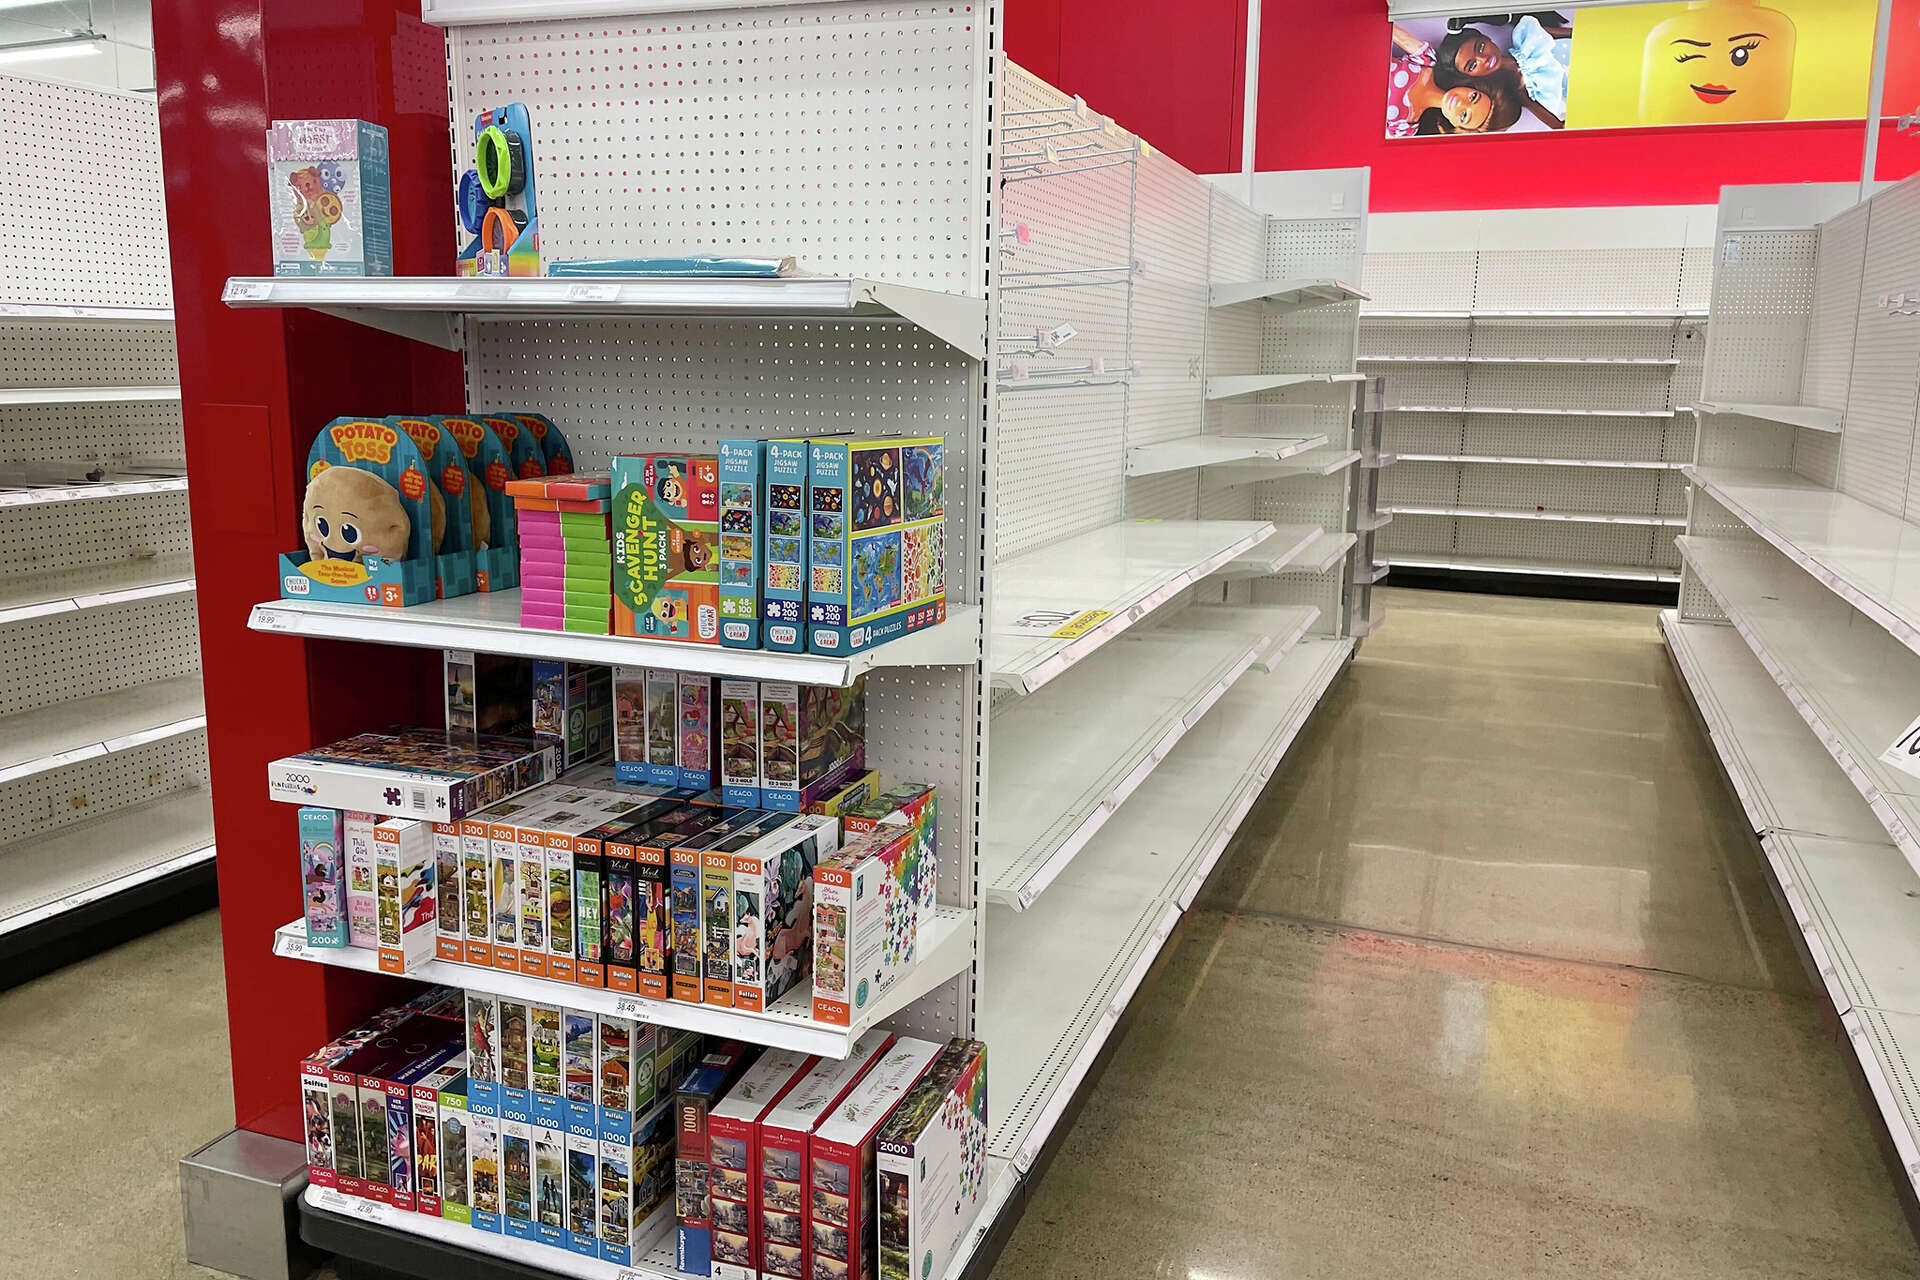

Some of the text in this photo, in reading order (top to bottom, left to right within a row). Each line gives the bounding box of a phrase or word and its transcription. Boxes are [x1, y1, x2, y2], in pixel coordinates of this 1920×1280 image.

[333, 424, 396, 444] POTATO
[342, 441, 388, 461] TOSS
[721, 444, 752, 457] 4-PACK
[770, 445, 802, 458] 4-PACK
[812, 448, 844, 460] 4-PACK
[702, 465, 714, 483] 6+
[616, 532, 626, 564] KIDS
[625, 490, 648, 606] SCAVENGER
[642, 516, 658, 580] HUNT
[386, 591, 398, 602] 3+
[738, 605, 752, 613] 100
[782, 608, 798, 617] 200
[258, 615, 275, 624] 19.99
[825, 612, 840, 621] 200
[865, 626, 872, 644] 4
[286, 773, 310, 783] 2000
[684, 772, 705, 780] CEACO
[437, 824, 454, 834] 300
[465, 826, 483, 835] 300
[851, 820, 870, 832] 300
[376, 830, 394, 840] 300
[494, 830, 512, 840] 300
[521, 833, 539, 844] 300
[549, 838, 568, 848] 300
[577, 842, 596, 853] 300
[611, 846, 630, 856] 300
[640, 851, 660, 863] 300
[674, 852, 694, 864] 300
[706, 856, 726, 868] 300
[737, 861, 757, 872] 300
[822, 872, 843, 884] 300
[286, 943, 302, 952] 35.99
[617, 1002, 635, 1012] 38.49
[817, 1004, 842, 1014] CEACO
[306, 1065, 323, 1074] 550
[304, 1079, 328, 1088] Selfies
[333, 1074, 350, 1083] 500
[363, 1079, 380, 1088] 500
[388, 1086, 405, 1096] 500
[415, 1089, 432, 1099] 500
[445, 1097, 462, 1106] 750
[472, 1104, 494, 1114] 1000
[504, 1111, 526, 1122] 1000
[684, 1107, 697, 1133] 1000
[536, 1117, 558, 1129] 1000
[570, 1125, 592, 1136] 1000
[603, 1132, 625, 1144] 1000
[880, 1142, 908, 1154] 2000
[312, 1169, 332, 1178] CEACO
[368, 1185, 388, 1193] CEACO
[446, 1206, 467, 1214] CEACO
[715, 1266, 721, 1276] 4
